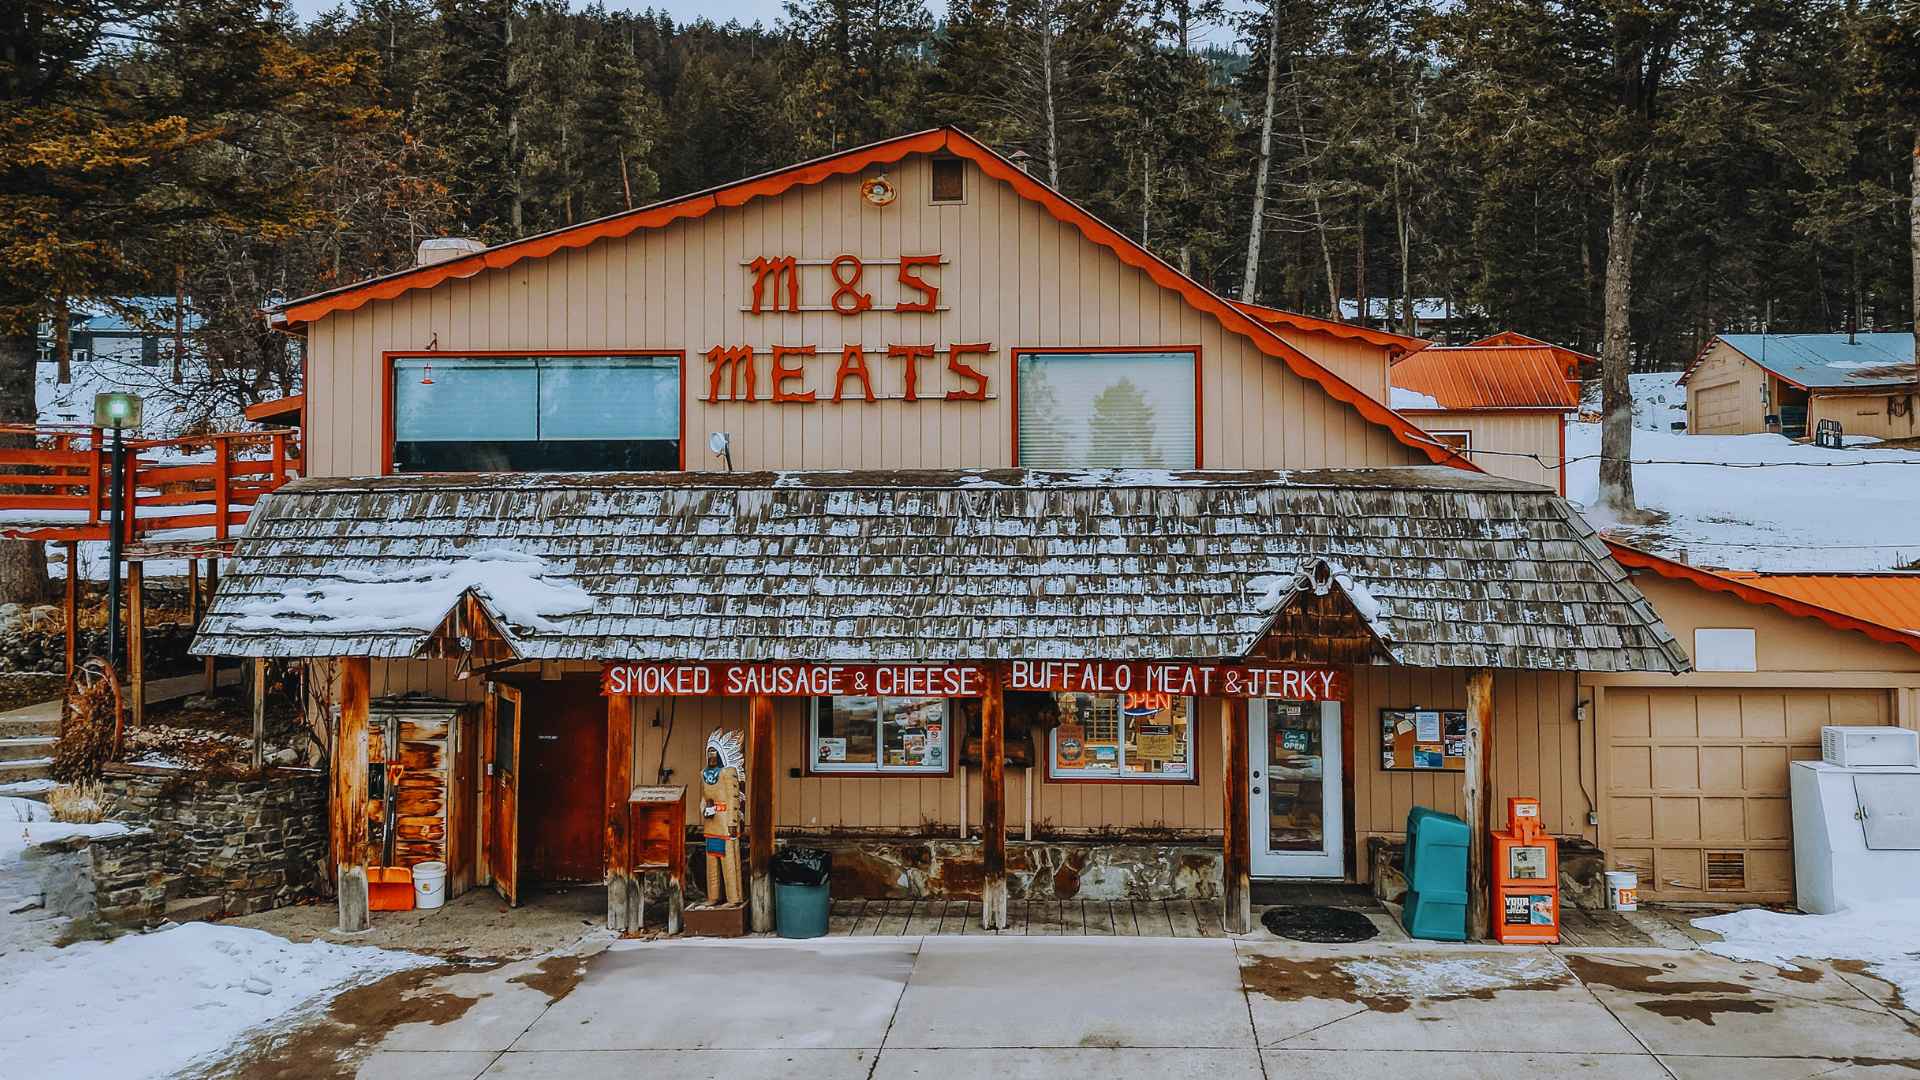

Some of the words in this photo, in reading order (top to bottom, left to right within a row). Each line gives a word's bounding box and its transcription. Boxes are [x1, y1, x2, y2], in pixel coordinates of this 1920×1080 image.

[751, 255, 800, 316] M
[831, 254, 873, 315] &
[894, 254, 943, 313] S
[706, 343, 992, 404] MEATS
[609, 666, 711, 694] SMOKED
[727, 666, 844, 694] SAUSAGE
[853, 671, 869, 691] &
[875, 667, 978, 695] CHEESE
[1011, 661, 1132, 692] BUFFALO
[1146, 665, 1216, 694] MEAT
[1225, 670, 1242, 694] &
[1248, 669, 1335, 700] JERKY
[1283, 742, 1305, 751] OPEN
